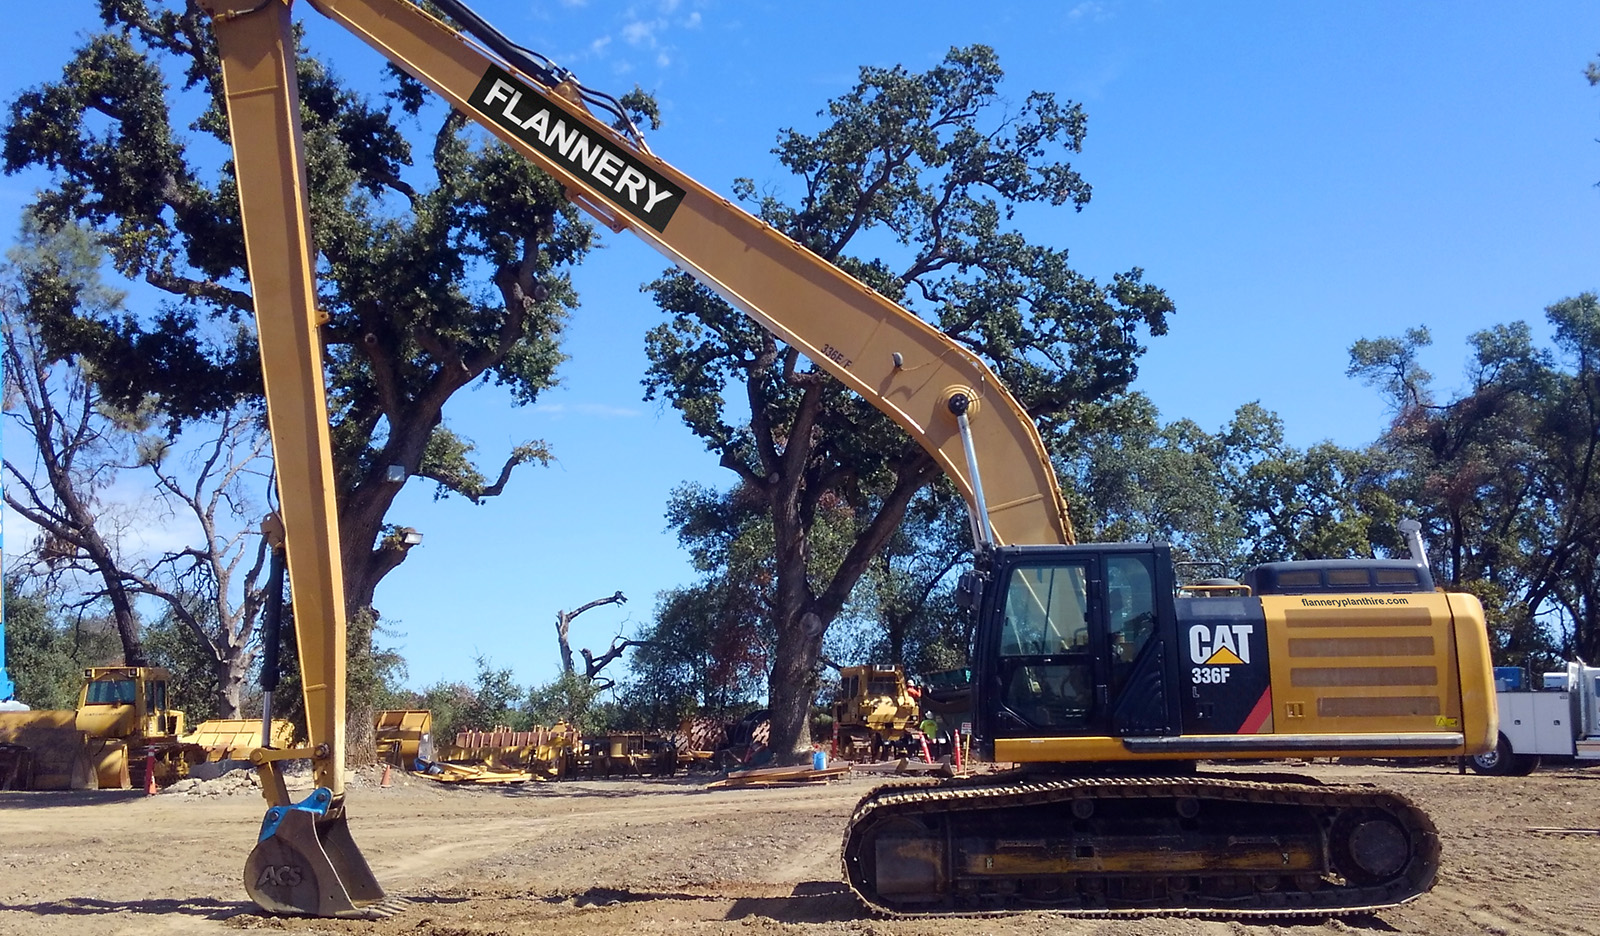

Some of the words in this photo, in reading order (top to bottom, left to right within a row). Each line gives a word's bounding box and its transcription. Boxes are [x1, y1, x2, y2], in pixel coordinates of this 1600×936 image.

[483, 78, 673, 213] FLANNERY
[820, 343, 853, 369] 336E/F
[1301, 597, 1409, 607] flanneryplanthire.com
[1189, 624, 1253, 664] CAT
[1191, 667, 1230, 684] 336F
[254, 865, 302, 891] ACS
